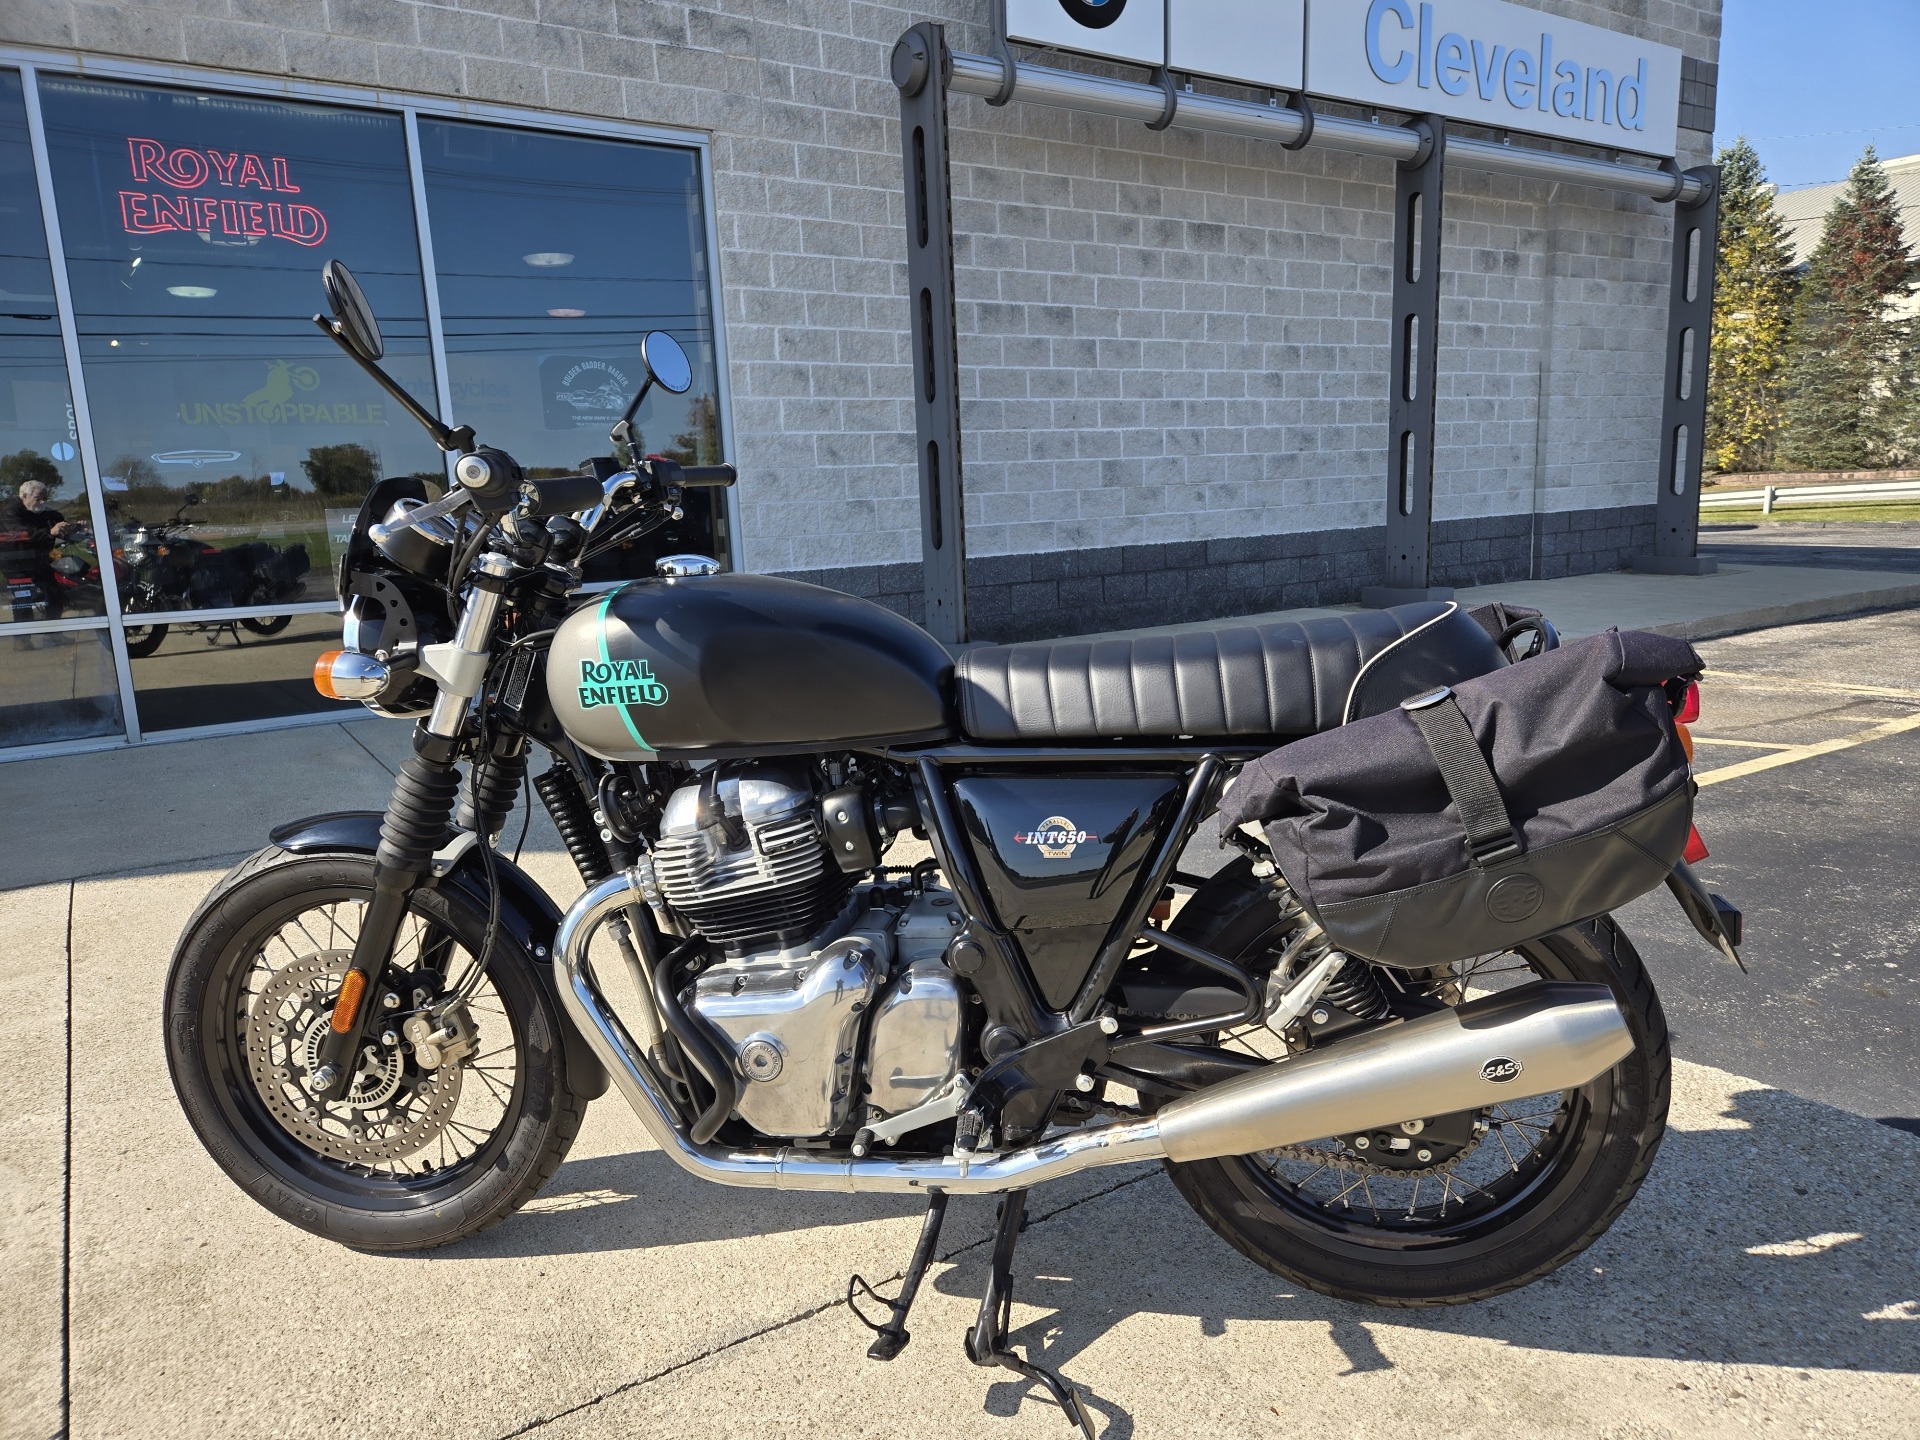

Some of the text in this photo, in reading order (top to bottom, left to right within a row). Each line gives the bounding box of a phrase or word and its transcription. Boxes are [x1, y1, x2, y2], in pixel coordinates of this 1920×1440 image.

[1365, 0, 1649, 131] Cleveland
[127, 137, 301, 193] ROYAL
[118, 190, 328, 247] ENFIELD
[178, 402, 385, 427] UNSTOPPABLE
[579, 659, 655, 684] ROYAL
[577, 683, 669, 709] ENFIELD
[1025, 830, 1087, 845] INT650
[1486, 1062, 1515, 1079] S&S
